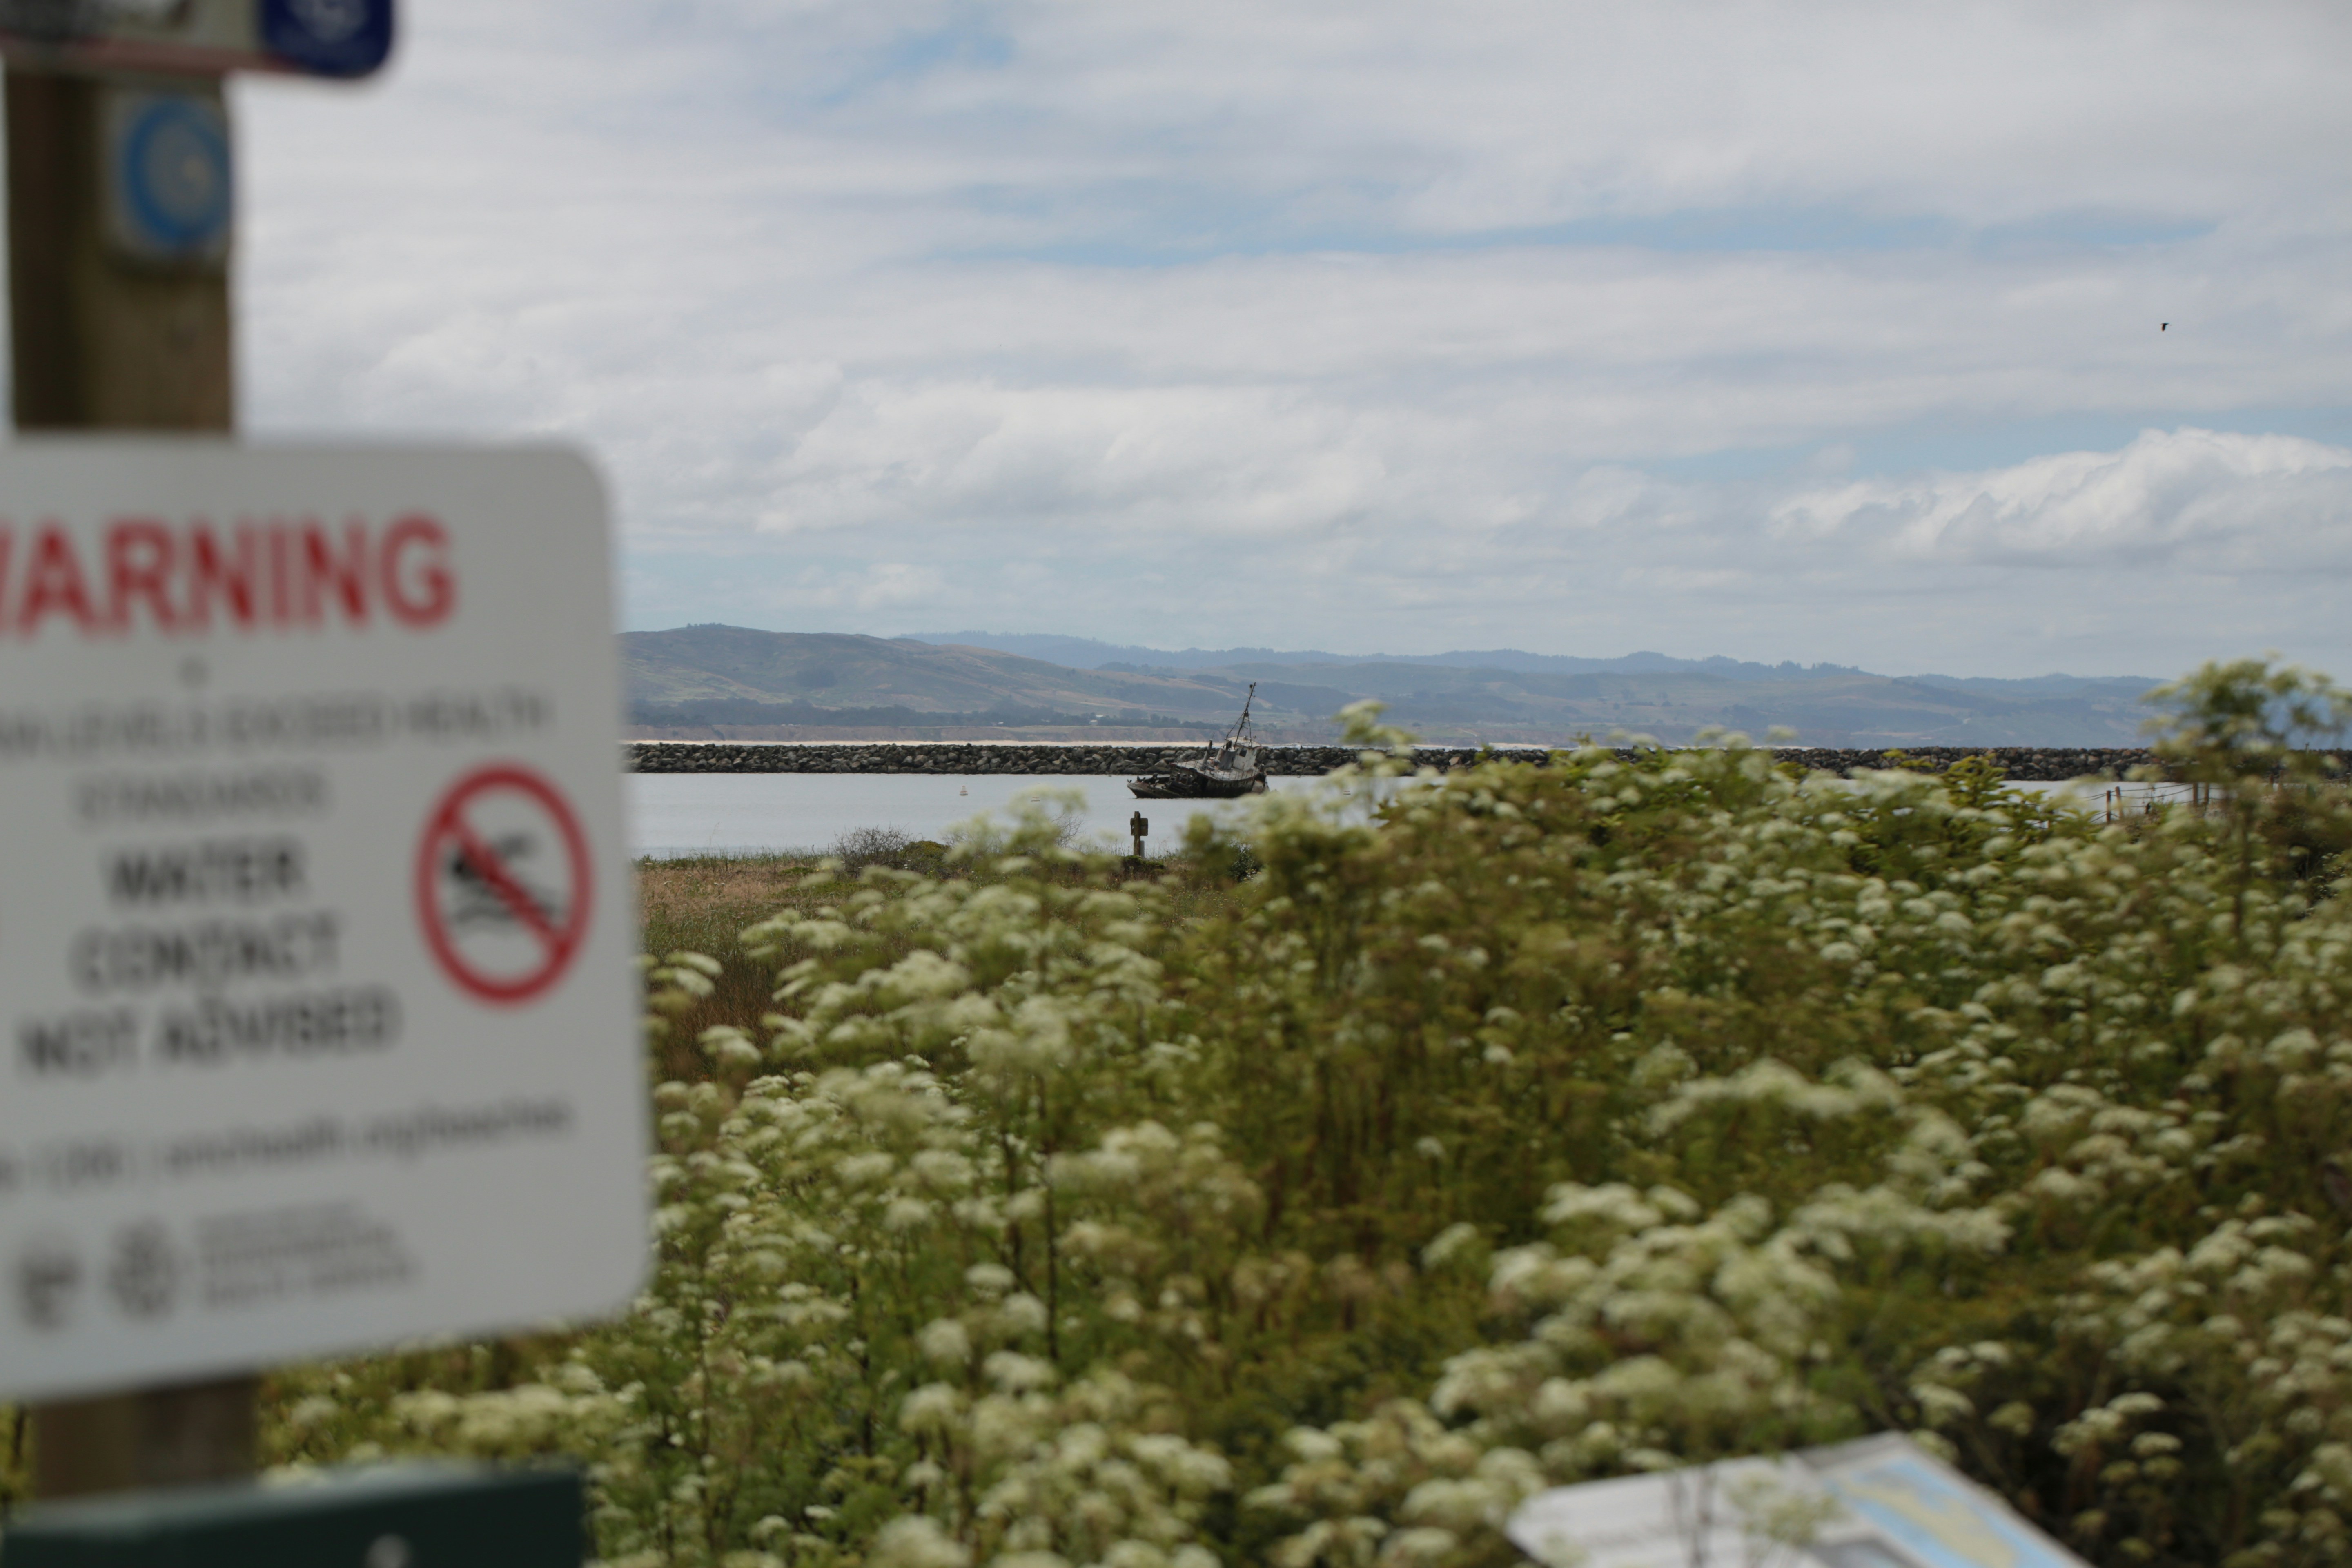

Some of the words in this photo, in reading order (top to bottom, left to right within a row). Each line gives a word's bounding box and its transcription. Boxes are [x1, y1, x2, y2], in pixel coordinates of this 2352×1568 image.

[105, 840, 306, 910] WATER
[73, 915, 342, 994] CONTACT
[20, 1009, 141, 1080] NOT
[156, 988, 399, 1067] ADVISED
